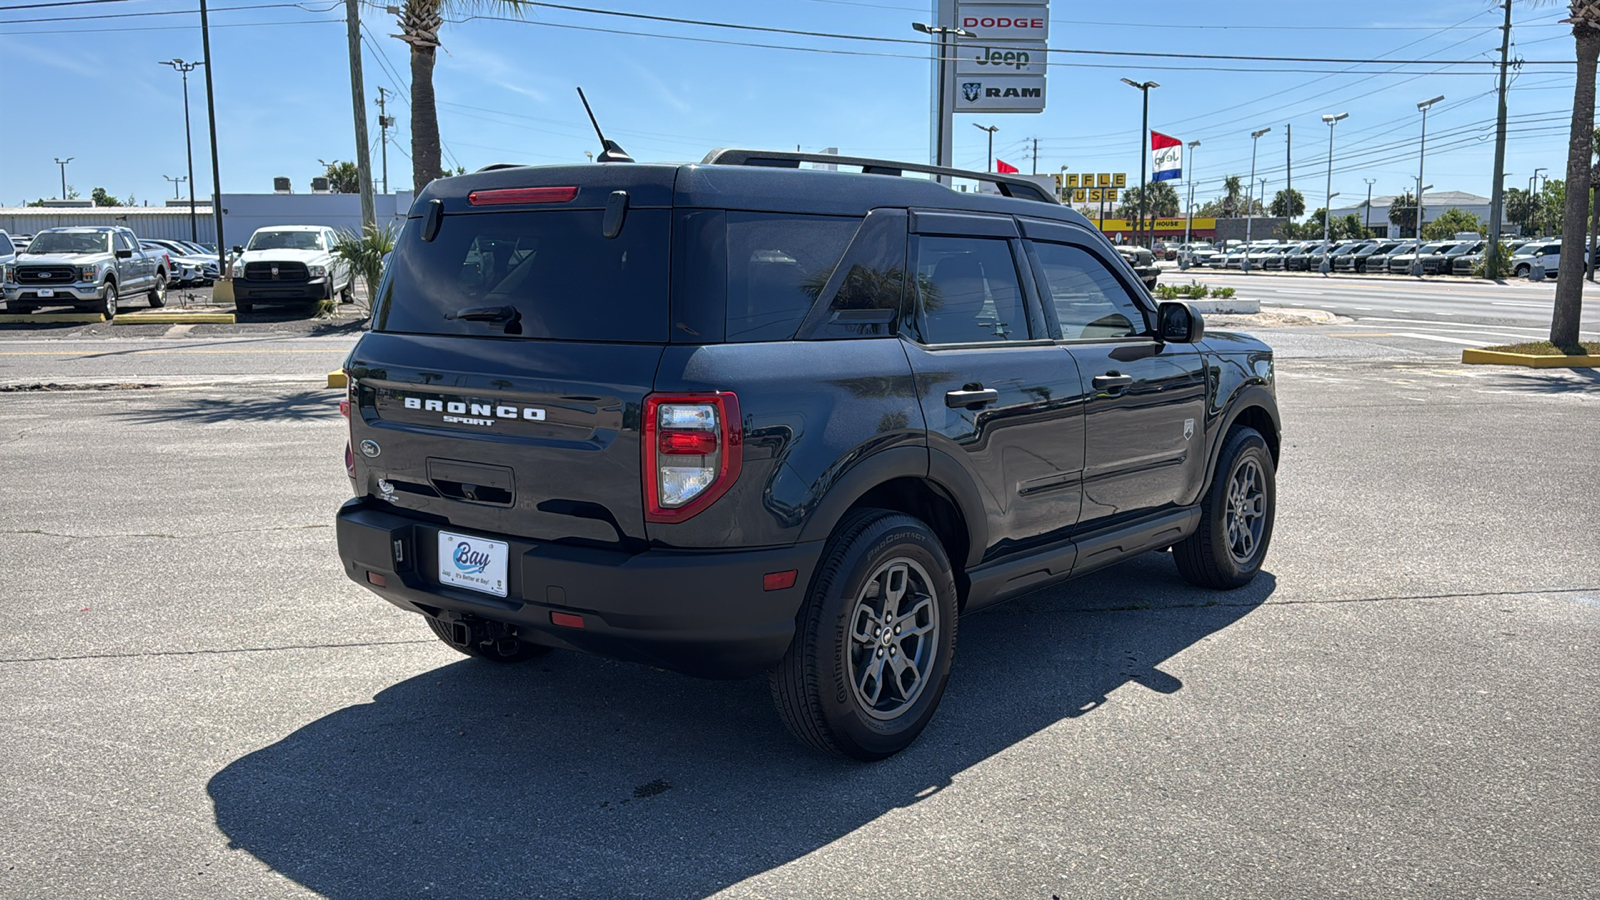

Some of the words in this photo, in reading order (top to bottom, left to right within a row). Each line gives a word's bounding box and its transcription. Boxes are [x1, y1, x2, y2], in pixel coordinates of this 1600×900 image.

[964, 17, 1044, 29] DODGE
[975, 47, 1030, 70] Jeep
[985, 87, 1041, 98] RAM
[1056, 175, 1124, 185] AFFLE
[1076, 191, 1116, 200] USE
[404, 397, 546, 421] BRONCO
[443, 415, 495, 426] SPORT
[456, 541, 491, 573] Bay
[462, 574, 475, 582] Better
